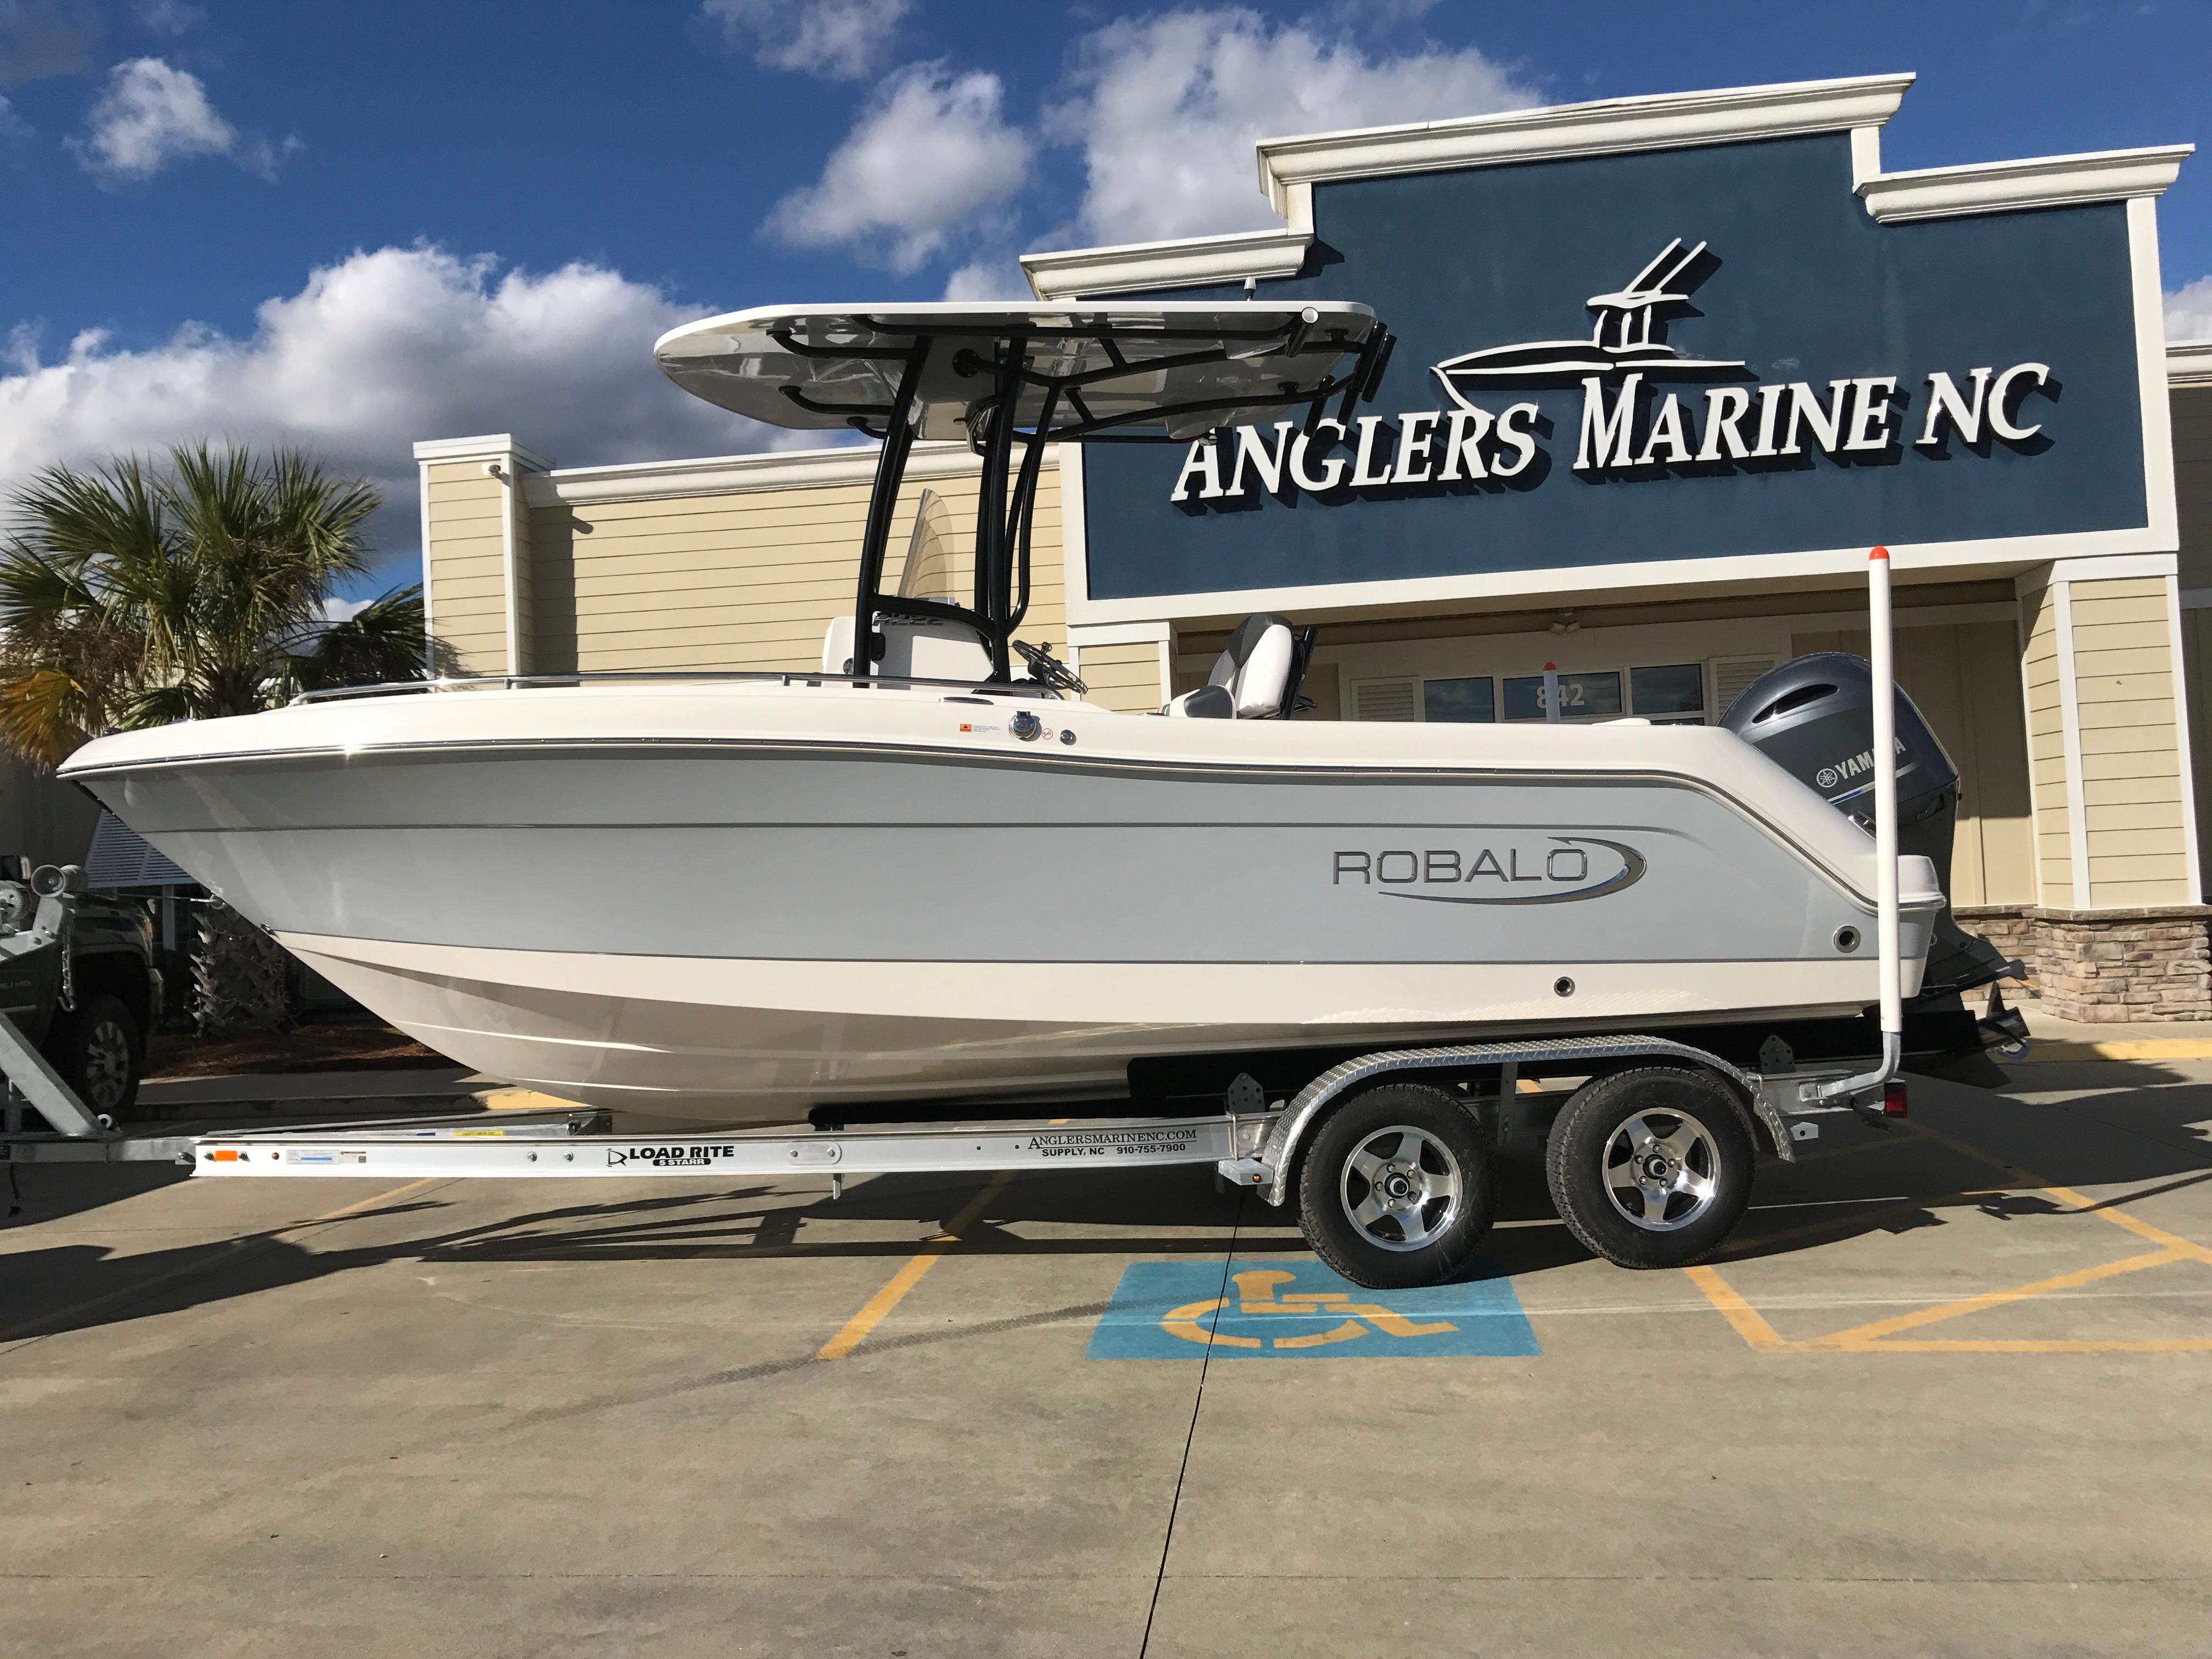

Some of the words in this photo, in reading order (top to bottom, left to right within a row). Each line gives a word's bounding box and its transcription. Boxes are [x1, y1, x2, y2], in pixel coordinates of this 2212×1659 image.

[1171, 402, 1538, 501] ANGLERS
[1573, 373, 1897, 469] MARINE
[1916, 362, 2050, 444] NC
[1834, 736, 1906, 780] YAMA
[1333, 849, 1588, 884] ROBALO
[630, 1147, 685, 1159] LOAD
[690, 1146, 735, 1158] RITE
[1028, 1129, 1198, 1149] ANGLERSMARINENC.COM
[1042, 1148, 1086, 1156] SUPPLY,
[1090, 1147, 1105, 1155] NC
[1117, 1143, 1186, 1155] 910-755-7900
